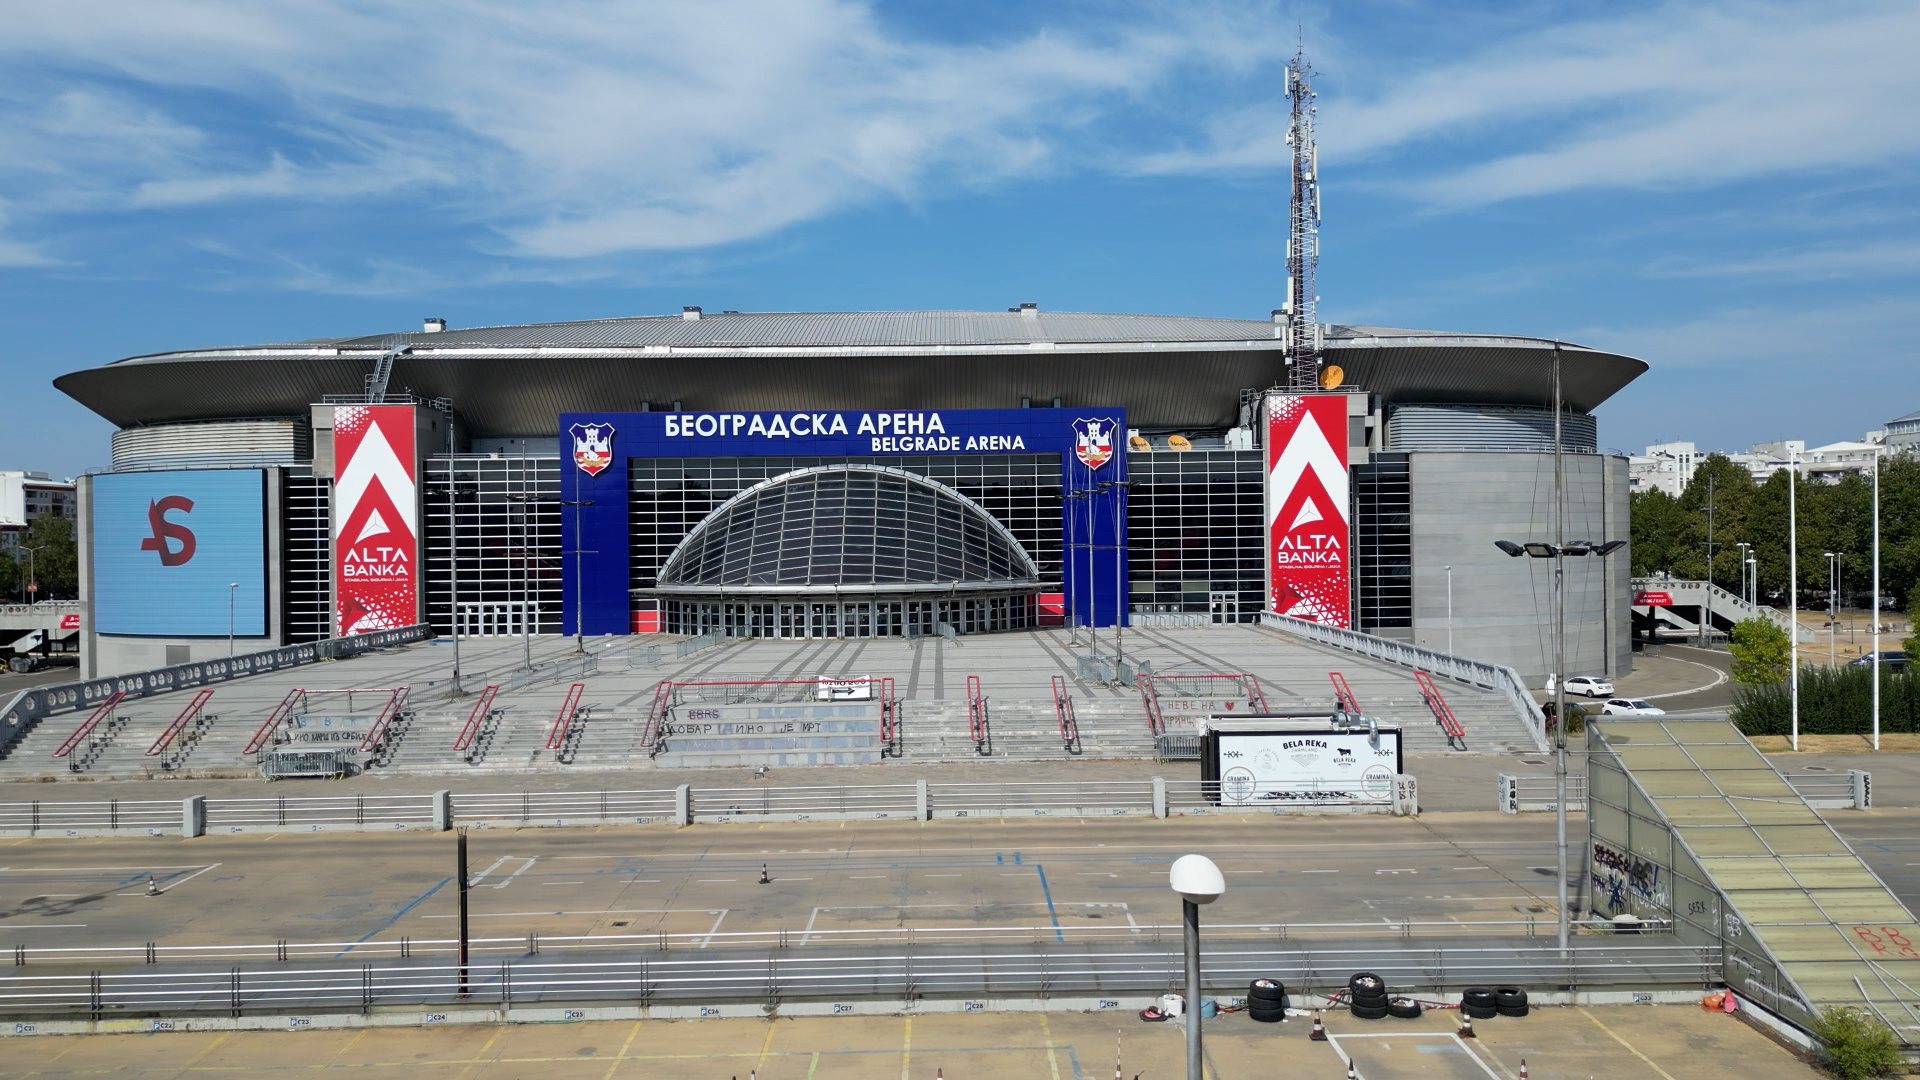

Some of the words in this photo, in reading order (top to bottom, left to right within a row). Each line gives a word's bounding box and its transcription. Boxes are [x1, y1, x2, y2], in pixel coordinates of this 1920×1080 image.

[664, 413, 849, 440] БЕОГРАДСКА
[856, 412, 945, 436] АРЕНА
[871, 437, 960, 453] BELGRADE
[965, 435, 1026, 451] ARENA
[1278, 534, 1341, 549] ALTA
[344, 547, 408, 562] ALTA
[1278, 551, 1342, 563] BANKA
[343, 564, 408, 576] BANKA
[1282, 740, 1303, 750] BELA
[1305, 740, 1328, 749] REKA
